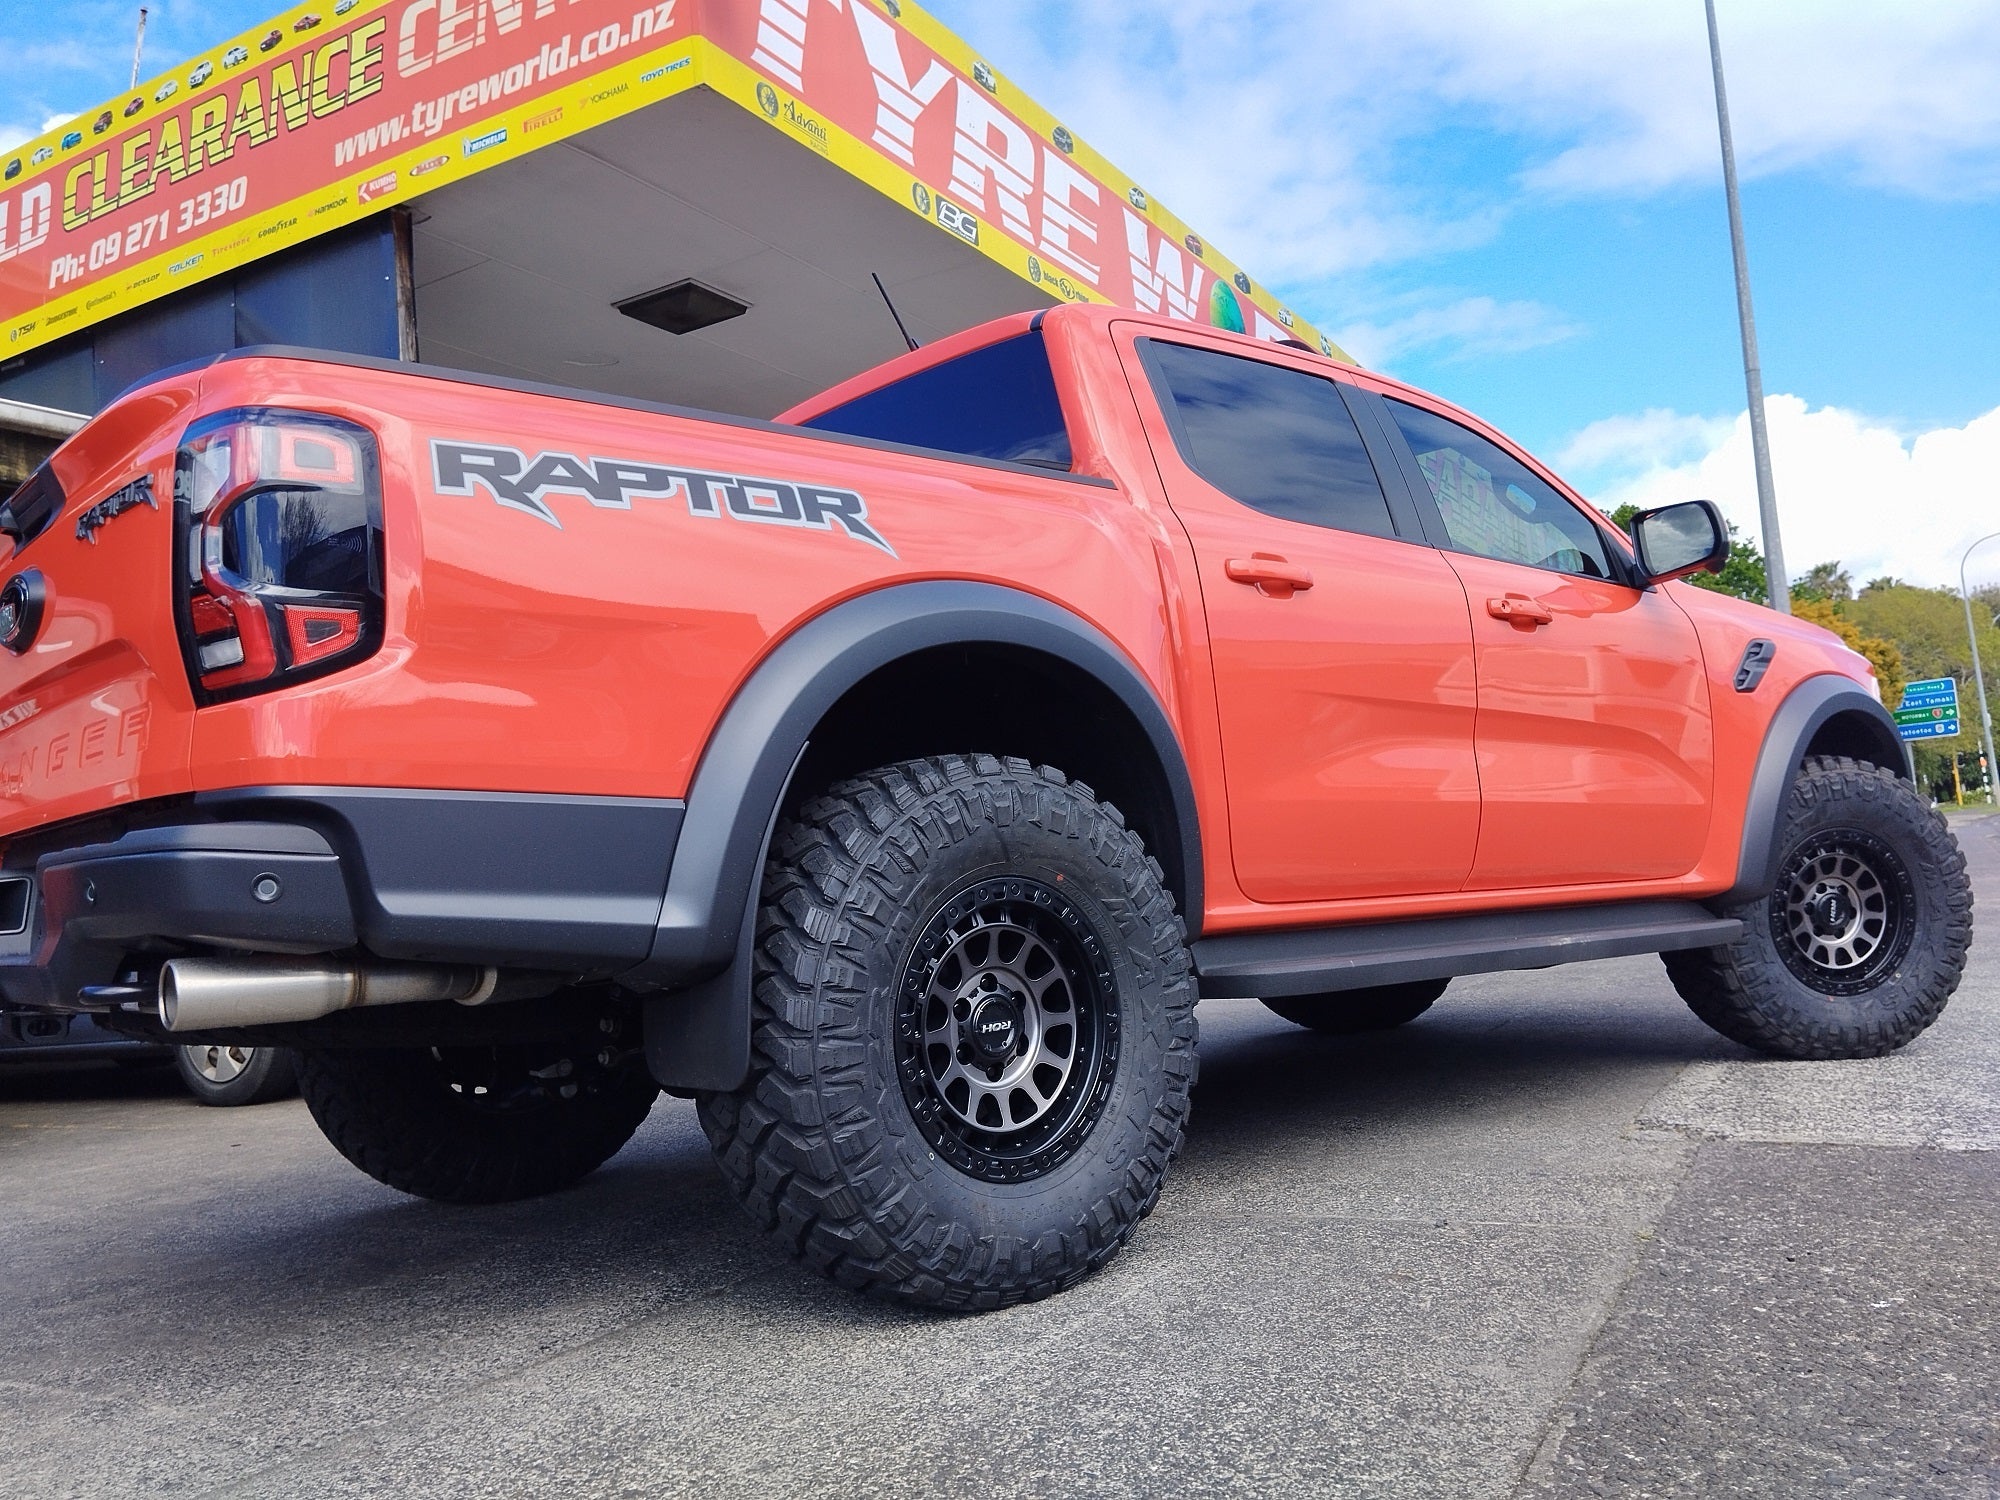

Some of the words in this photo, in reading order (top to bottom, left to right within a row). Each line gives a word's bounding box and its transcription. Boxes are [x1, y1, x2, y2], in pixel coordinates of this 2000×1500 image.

[334, 0, 676, 167] www.tyreworld.co.nz
[640, 68, 664, 84] TOYO
[665, 57, 691, 76] TIRES
[590, 83, 630, 104] YOKOHAMA
[63, 16, 387, 233] CLEARANCE
[523, 107, 564, 133] PIRELLI
[784, 100, 827, 141] Advanti
[471, 130, 507, 151] MICHELIN
[750, 0, 1101, 285] TYRE
[369, 172, 396, 191] KUMHO
[49, 253, 86, 290] Ph:
[89, 231, 122, 271] 09
[125, 207, 170, 257] 271
[176, 176, 248, 235] 3330
[212, 236, 251, 257] Firestone
[168, 254, 205, 276] FALKEN
[428, 437, 900, 560] RAPTOR
[982, 1020, 1012, 1034] ROH
